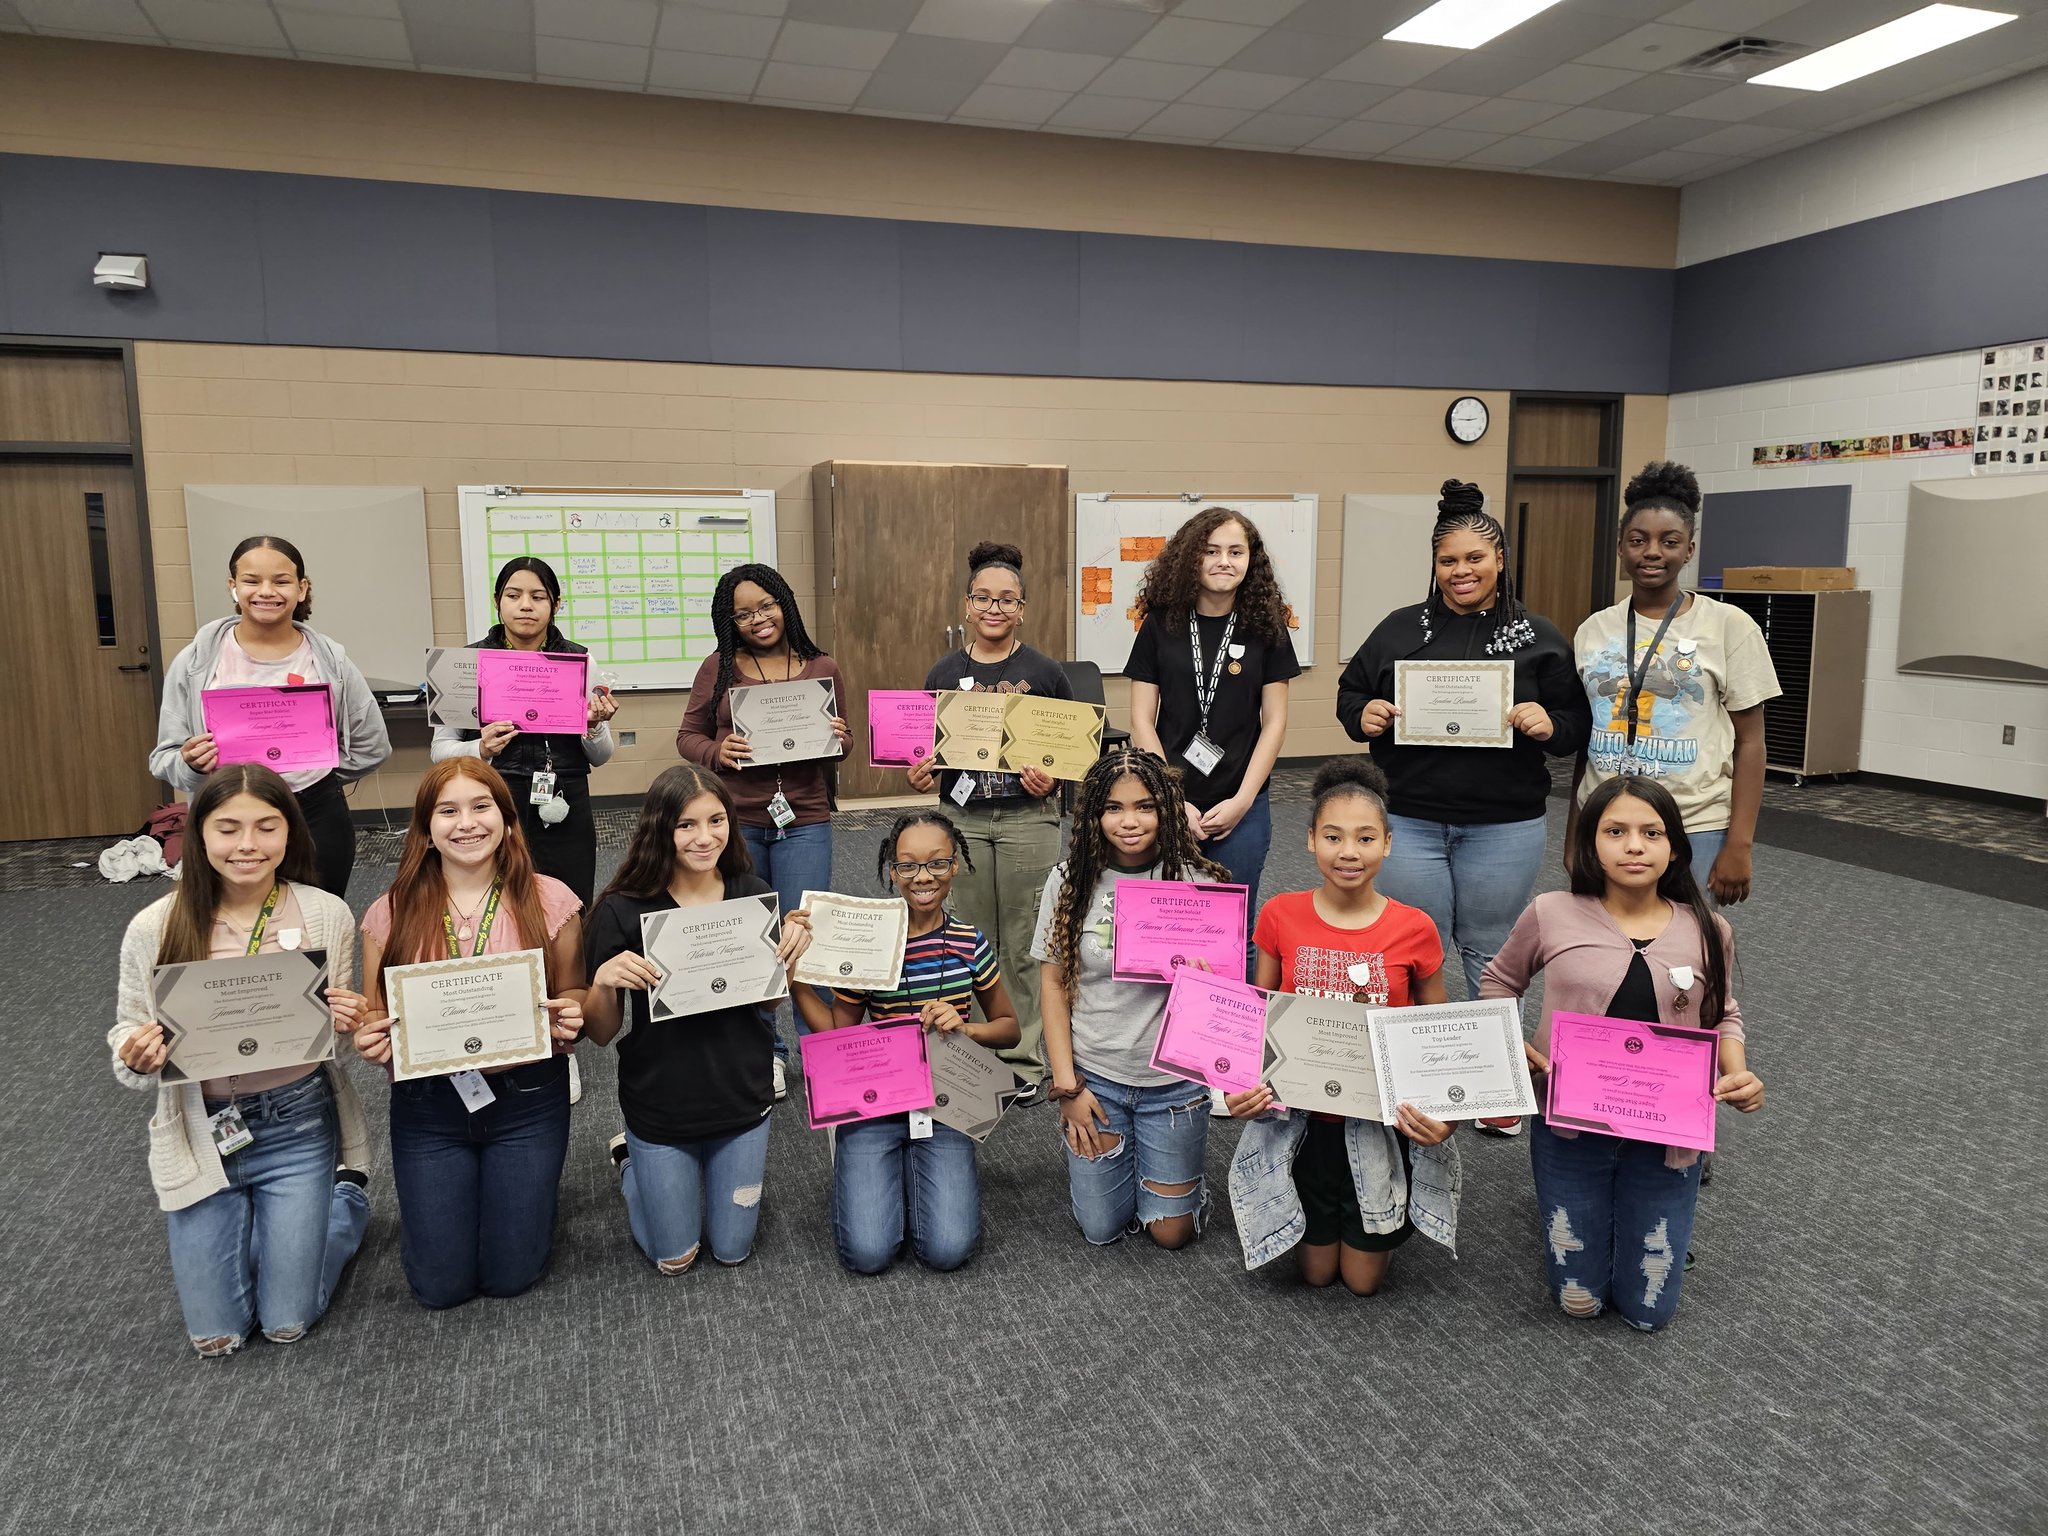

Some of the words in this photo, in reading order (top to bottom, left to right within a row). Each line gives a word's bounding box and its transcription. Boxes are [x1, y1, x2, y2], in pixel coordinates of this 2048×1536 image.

[595, 512, 640, 527] MAY
[508, 665, 558, 673] CERTIFICATE
[240, 700, 297, 709] CERTIFICATE
[760, 694, 806, 704] CERTIFICATE
[964, 705, 1003, 713] CERTIFICAT
[1031, 709, 1078, 720] CERTIFICATE
[1150, 896, 1211, 907] CERTIFICATE
[831, 909, 883, 921] CERTIFICATE
[682, 917, 743, 934] CERTIFICATE
[709, 930, 732, 938] Improved
[1296, 945, 1385, 963] CELEBRATE
[1295, 956, 1385, 973] CELEBTE
[204, 973, 283, 989] CERTIFICATE
[431, 972, 503, 989] CERTIFICATE
[1294, 966, 1387, 983] CELEBTE
[237, 986, 268, 994] Improved
[458, 986, 493, 995] Outstanding
[1296, 986, 1388, 1004] CELEBRTE
[1209, 994, 1266, 1016] CERTIFICAT
[1216, 1007, 1230, 1015] Super
[1242, 1014, 1258, 1022] Soloist
[1411, 1022, 1478, 1034] CERTIFICATE
[1332, 1032, 1357, 1040] Improved
[837, 1036, 892, 1051] CERTIFICATE
[946, 1041, 994, 1075] CERTIFICATE
[1605, 1095, 1624, 1103] Soloist
[1593, 1102, 1666, 1122] CERTIFICATE
